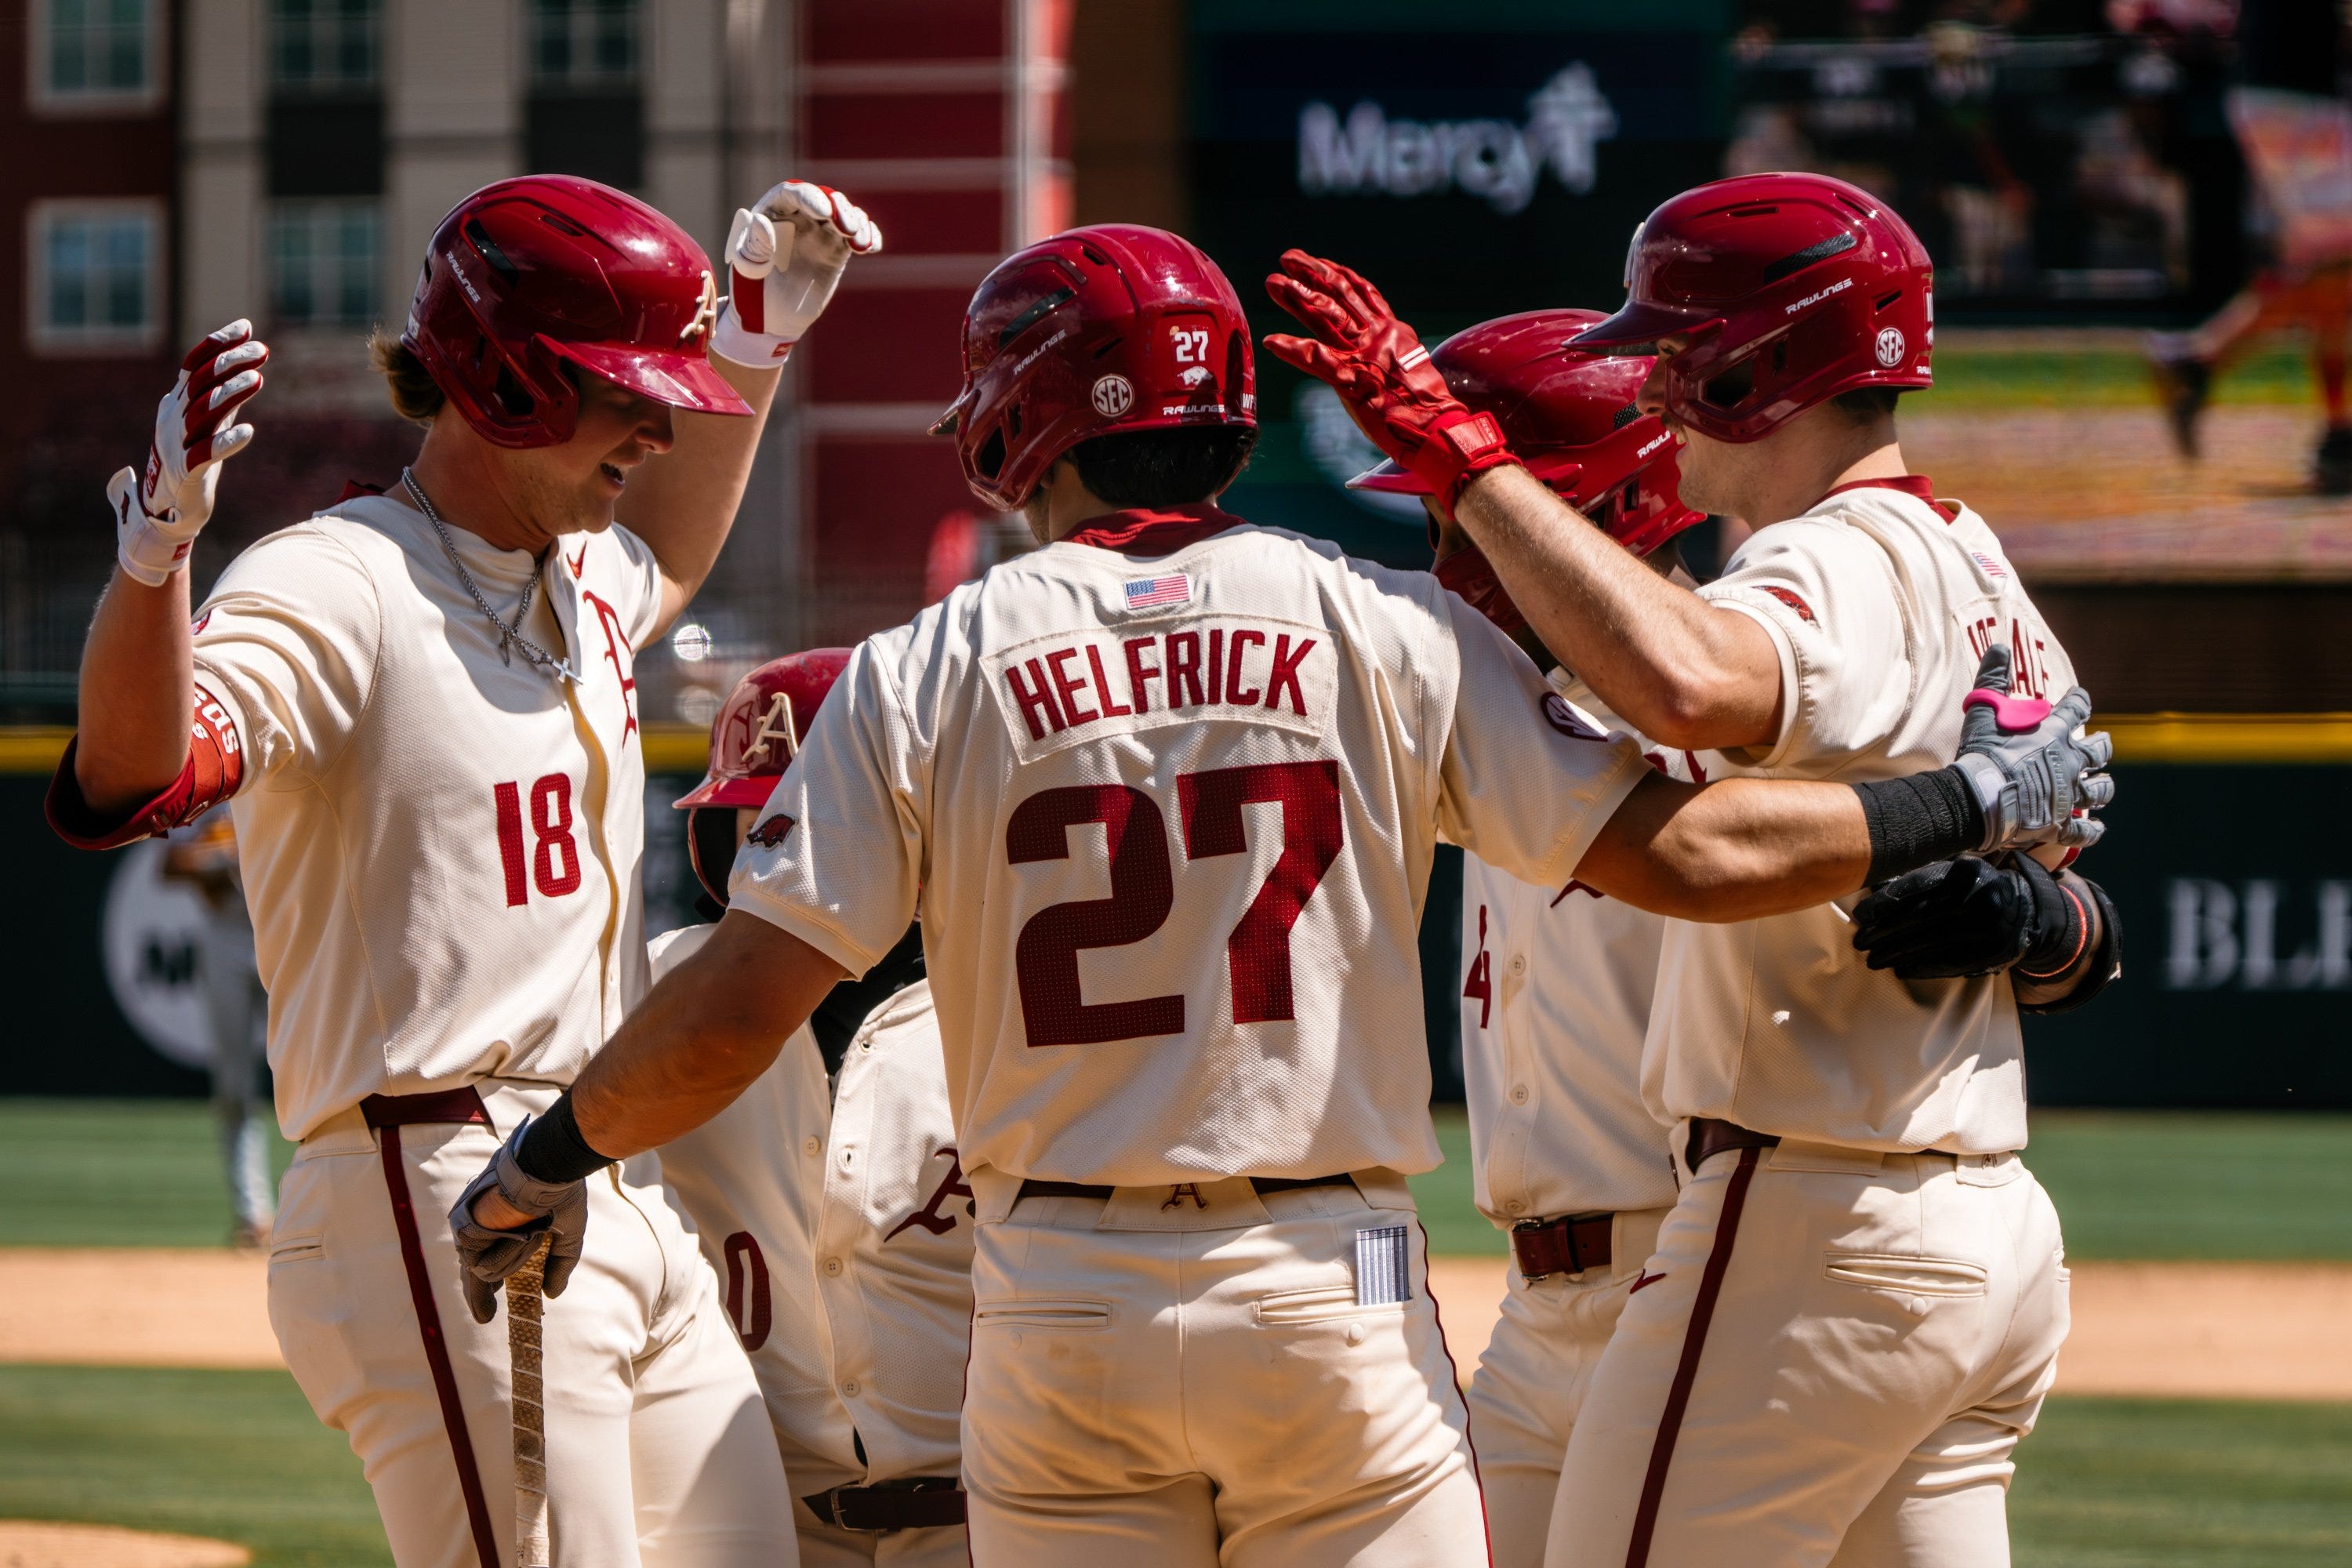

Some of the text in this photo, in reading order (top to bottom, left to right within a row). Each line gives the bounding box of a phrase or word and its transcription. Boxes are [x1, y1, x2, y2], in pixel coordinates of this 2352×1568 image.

[1298, 100, 1546, 213] Mercy
[446, 250, 481, 303] RAWLINGS
[1784, 277, 1853, 314] RAWLINGS
[1013, 328, 1067, 376] RAWLINGS
[1174, 331, 1209, 362] 27
[1878, 330, 1903, 363] SEC
[1095, 379, 1129, 414] SEC
[1163, 405, 1225, 416] RAWLINGS
[1637, 430, 1671, 459] RAWLI
[1005, 629, 1317, 741] HELFRICK
[741, 691, 800, 762] A
[494, 771, 583, 908] 18
[1006, 760, 1344, 1047] 27
